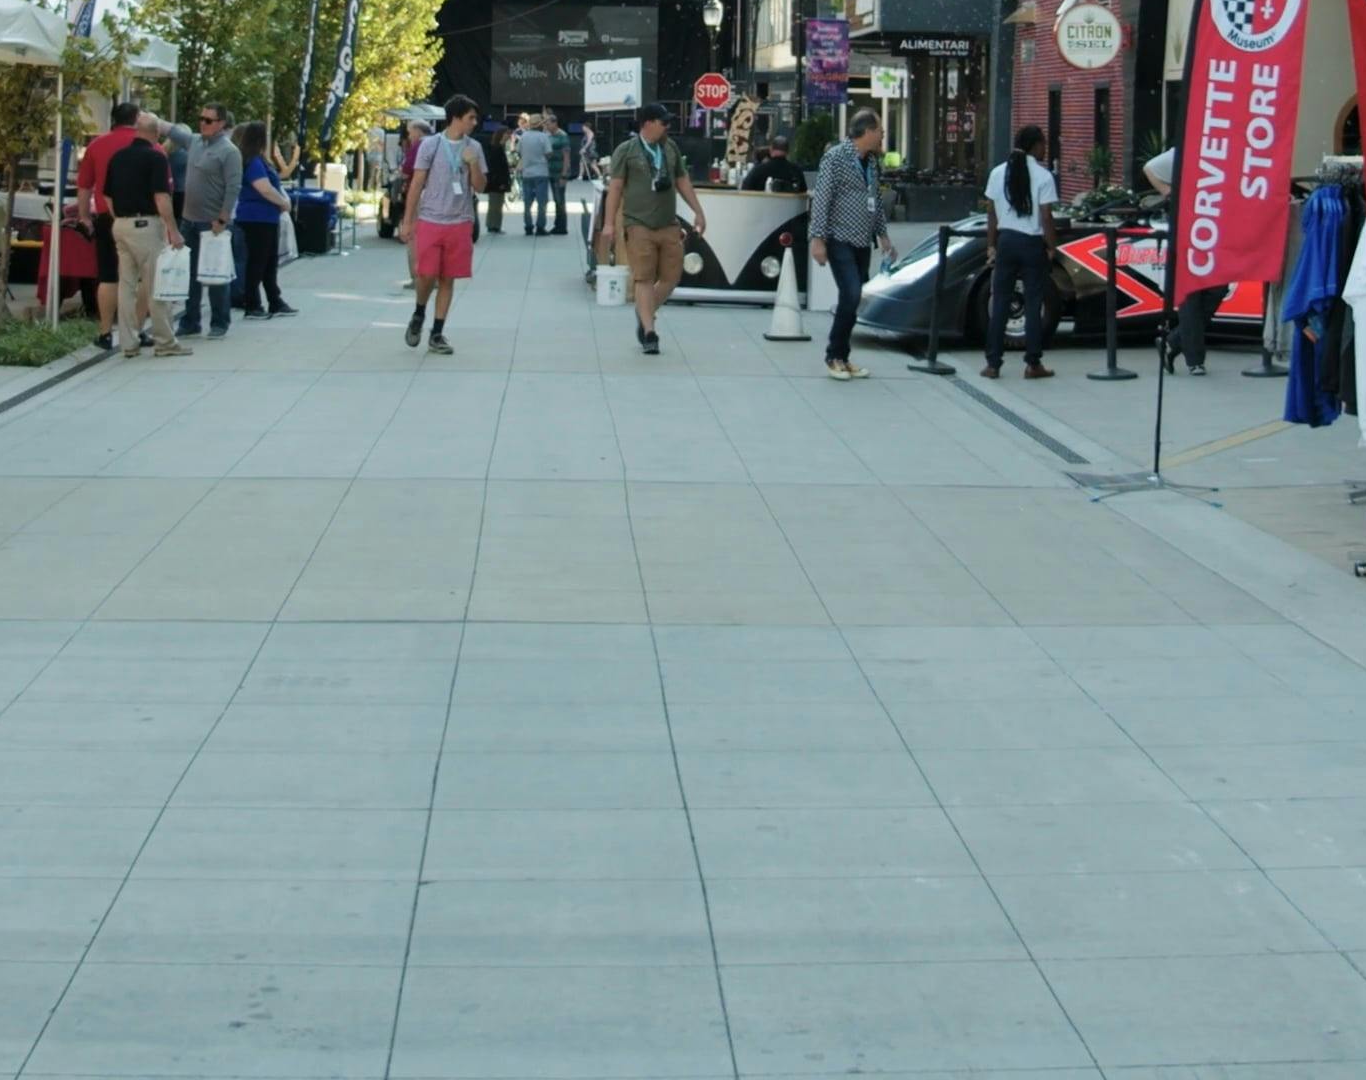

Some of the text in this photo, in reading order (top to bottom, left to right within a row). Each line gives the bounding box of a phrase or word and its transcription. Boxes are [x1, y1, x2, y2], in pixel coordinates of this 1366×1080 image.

[1067, 25, 1112, 39] CITRON
[1227, 28, 1275, 49] Museum
[899, 39, 970, 50] ALIMENTARI
[588, 69, 635, 86] COCKTAILS
[697, 84, 728, 99] STOP
[1239, 62, 1281, 201] STORE
[1186, 58, 1238, 277] CORVETTE
